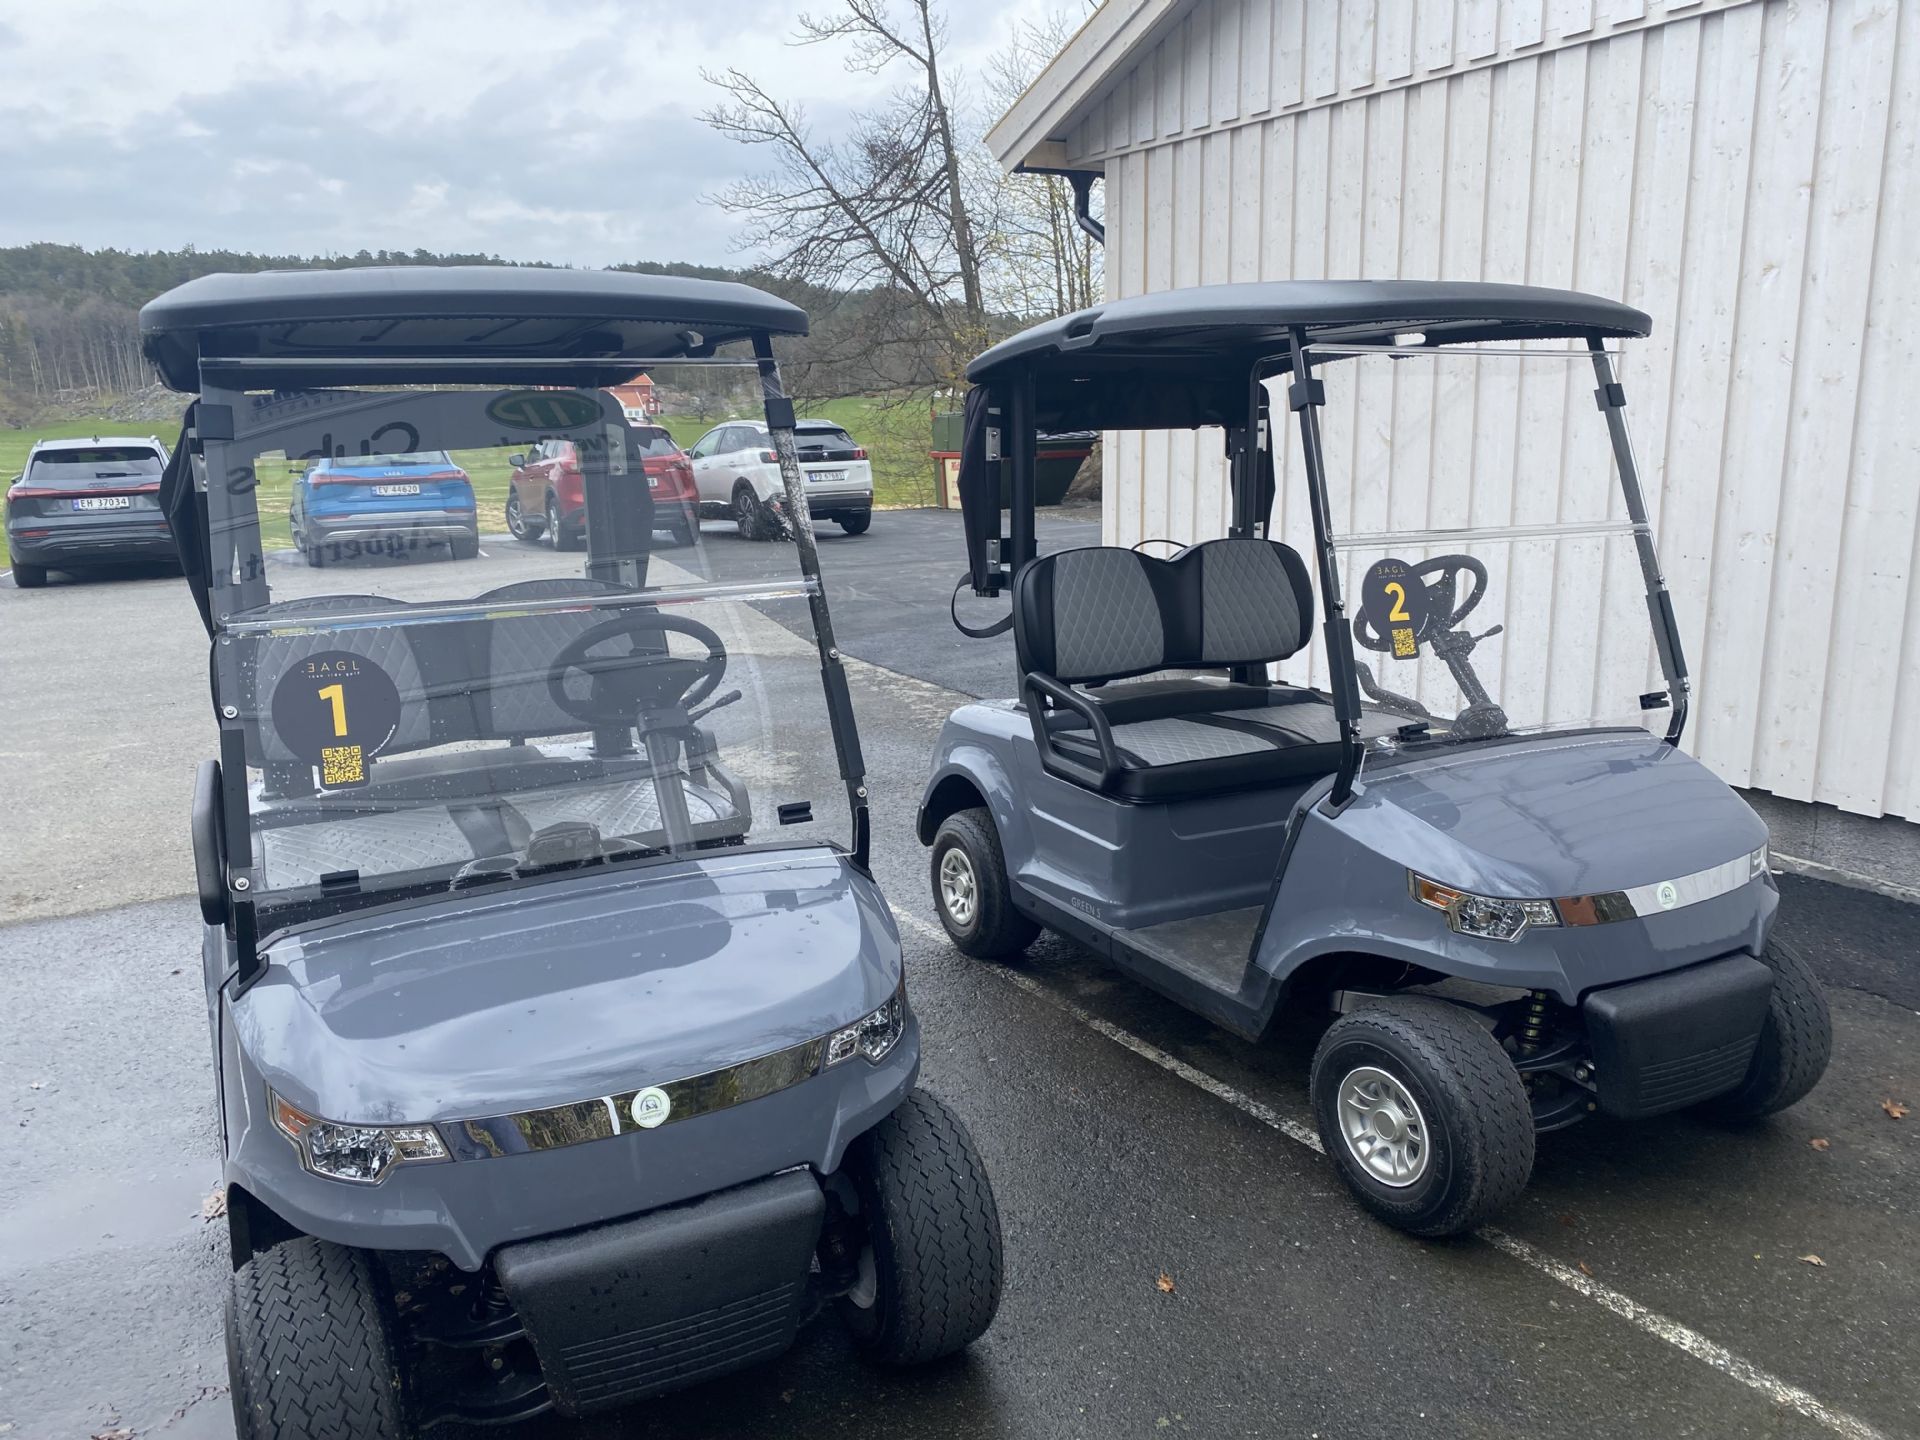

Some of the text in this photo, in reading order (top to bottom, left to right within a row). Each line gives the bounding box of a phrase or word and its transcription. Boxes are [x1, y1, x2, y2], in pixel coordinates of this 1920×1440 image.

[80, 498, 127, 508] EH 37034
[1384, 581, 1410, 622] 2
[318, 684, 348, 737] 1
